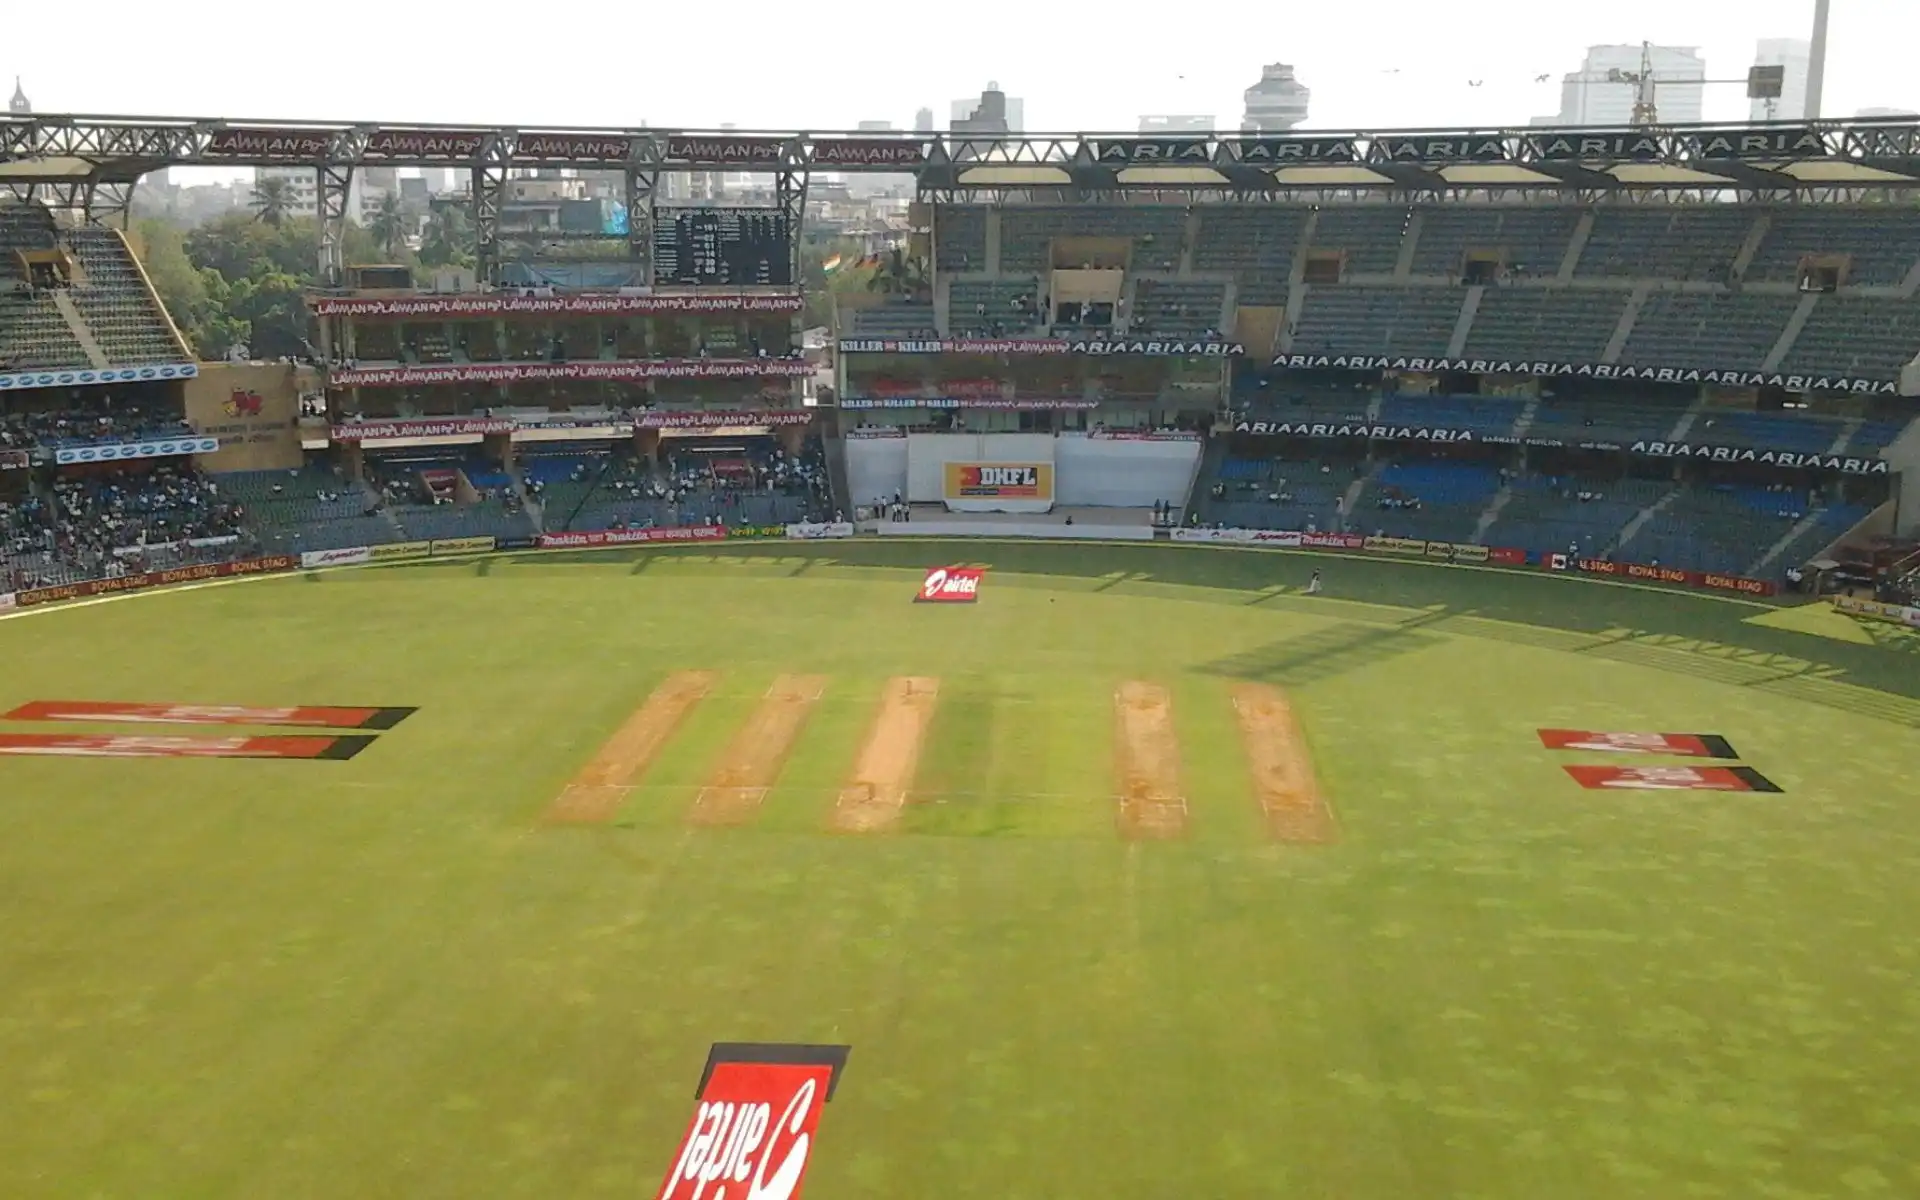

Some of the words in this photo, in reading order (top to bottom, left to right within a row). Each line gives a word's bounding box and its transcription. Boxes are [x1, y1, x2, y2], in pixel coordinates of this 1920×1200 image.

[1101, 144, 1208, 159] ARIA
[1250, 142, 1353, 158] ARIA
[1398, 140, 1503, 157] ARIA
[1546, 138, 1657, 155] ARIA
[1707, 135, 1821, 151] ARIA
[840, 340, 883, 352] KILLER
[898, 340, 941, 352] KILLER
[1073, 342, 1127, 353] ARIA
[1131, 342, 1185, 353] ARIA
[1189, 343, 1244, 354] ARIA
[1273, 355, 1328, 367] ARIA
[1333, 356, 1388, 368] ARIA
[1392, 358, 1450, 370] ARIA
[1454, 360, 1511, 372] ARIA
[1515, 362, 1573, 375] ARIA
[1577, 364, 1636, 378] ARIA
[1640, 367, 1699, 381] ARIA
[1704, 370, 1764, 385] ARIA
[1768, 373, 1829, 389] ARIA
[1832, 377, 1895, 393] ARIA
[1236, 421, 1291, 433] ARIA
[1295, 423, 1350, 435] ARIA
[1354, 425, 1410, 438] ARIA
[1415, 427, 1473, 441] ARIA
[1631, 441, 1691, 455] ARIA
[1695, 446, 1755, 461] ARIA
[1759, 452, 1821, 466] ARIA
[1824, 457, 1887, 473] ARIA
[980, 467, 1036, 485] DHFL
[231, 560, 261, 573] ROYAL
[263, 556, 288, 570] STAG
[1589, 560, 1615, 573] STAG
[162, 569, 190, 583] ROYAL
[192, 565, 218, 579] STAG
[1628, 565, 1659, 578] ROYAL
[1660, 569, 1685, 583] STAG
[91, 579, 121, 594] ROYAL
[123, 575, 148, 590] STAG
[943, 574, 979, 592] airtel
[1705, 574, 1735, 589] ROYAL
[1737, 579, 1762, 593] STAG
[21, 589, 49, 603] ROYAL
[52, 586, 78, 601] STAG
